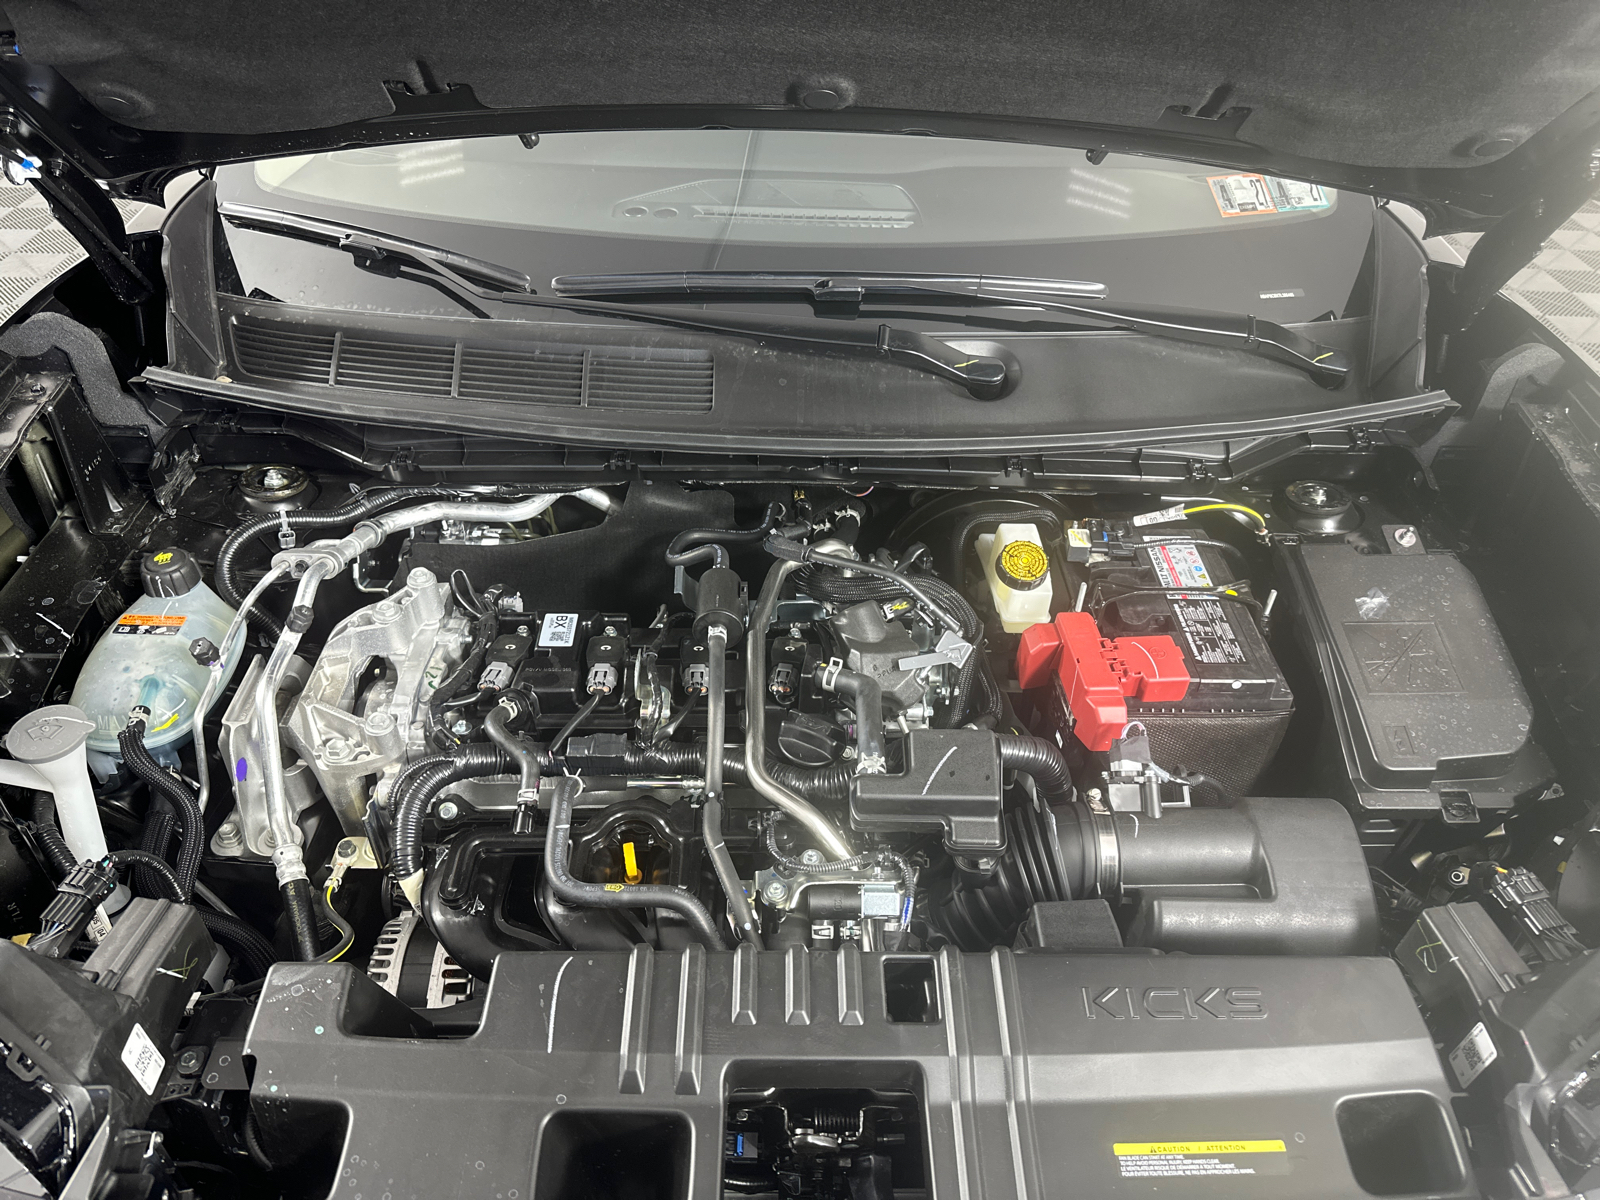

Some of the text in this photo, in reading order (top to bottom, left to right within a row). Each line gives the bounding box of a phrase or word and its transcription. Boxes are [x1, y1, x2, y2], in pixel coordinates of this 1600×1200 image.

[1219, 184, 1235, 209] 4
[1249, 178, 1269, 206] 27
[554, 615, 569, 629] BX
[1081, 987, 1269, 1019] KICKS
